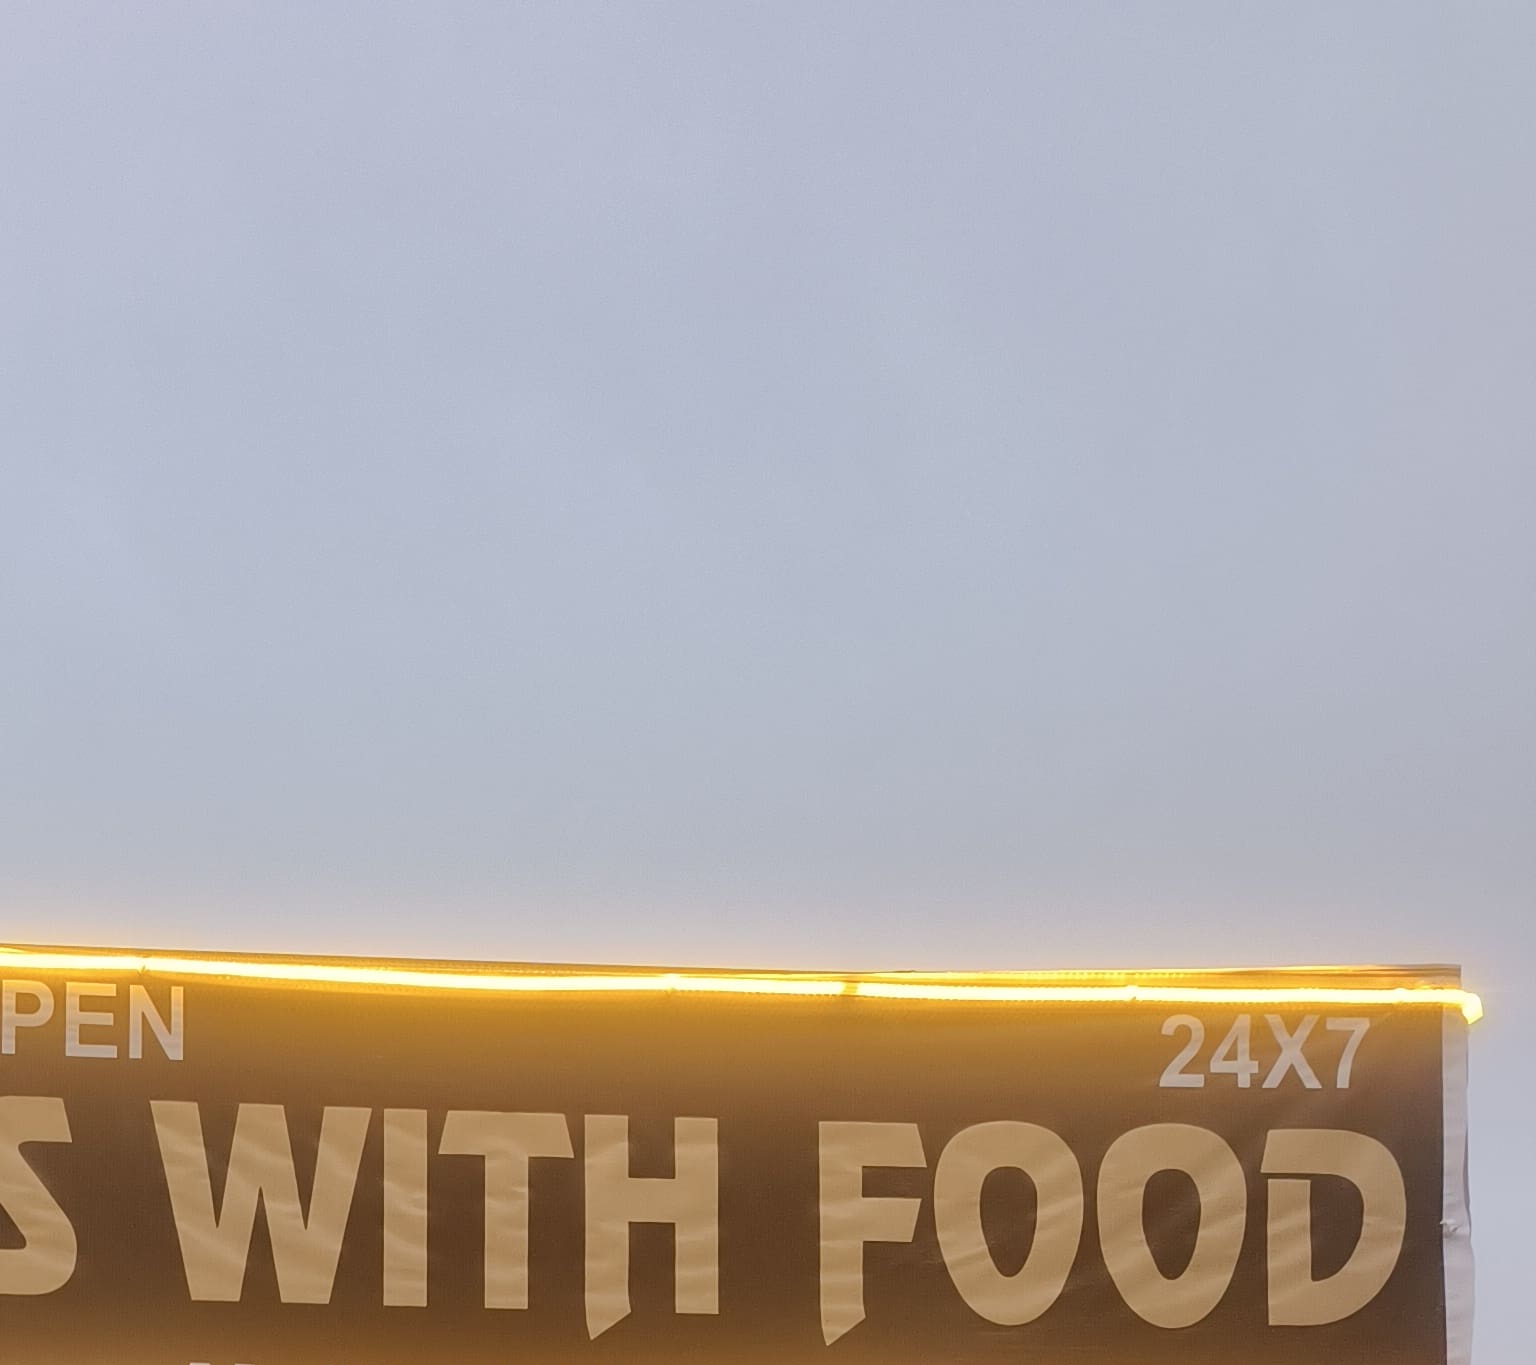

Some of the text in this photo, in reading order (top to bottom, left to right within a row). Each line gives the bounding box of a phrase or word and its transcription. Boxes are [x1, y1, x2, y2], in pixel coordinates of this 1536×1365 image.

[1159, 1014, 1371, 1089] 24X7
[149, 1099, 720, 1341] WITH
[819, 1120, 1407, 1346] FOOD
